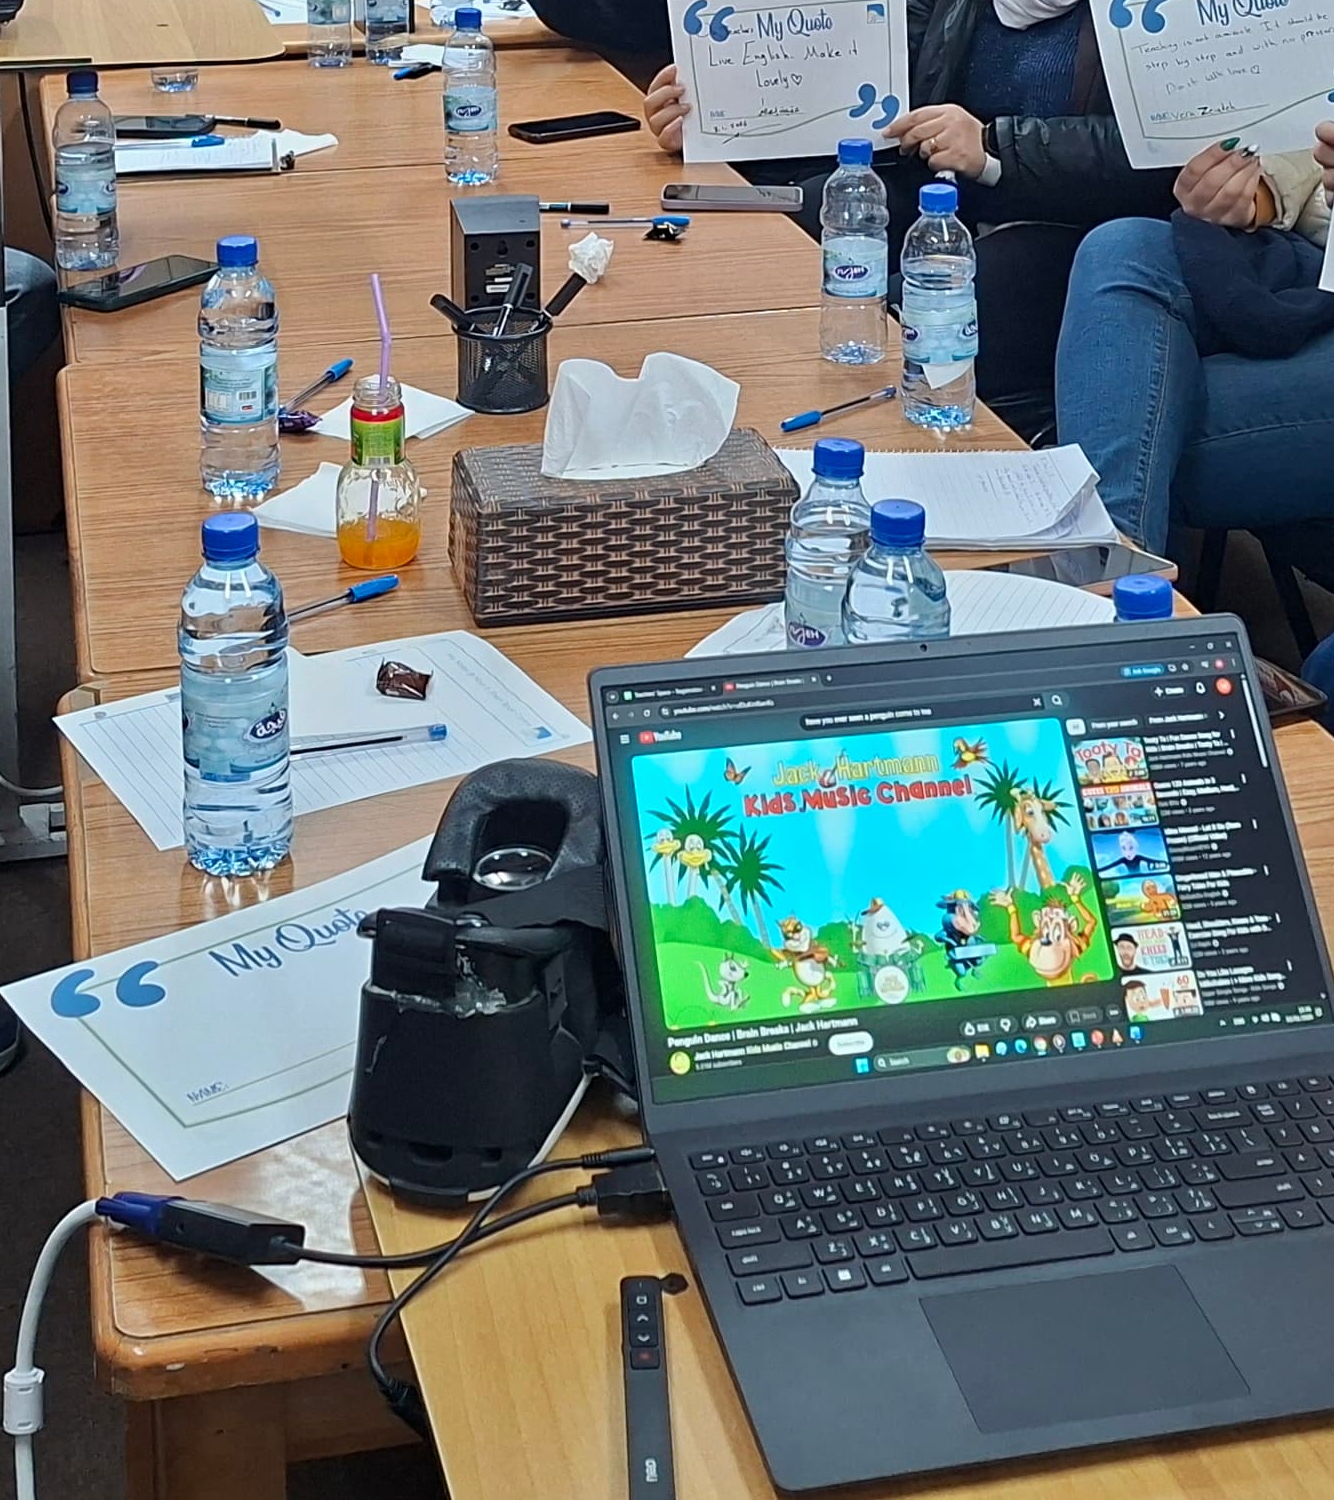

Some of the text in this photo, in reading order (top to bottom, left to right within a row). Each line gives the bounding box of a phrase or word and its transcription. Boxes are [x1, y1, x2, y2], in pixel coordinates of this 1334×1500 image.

[755, 8, 834, 42] My Quote
[709, 44, 735, 68] Live
[654, 730, 683, 743] YouTube
[772, 752, 940, 787] Jack Hartmann
[743, 775, 973, 818] Kids Music Channel
[208, 908, 368, 978] My Quote
[667, 1016, 859, 1048] Penguin Dance Brain Breaks Jack Hartmann
